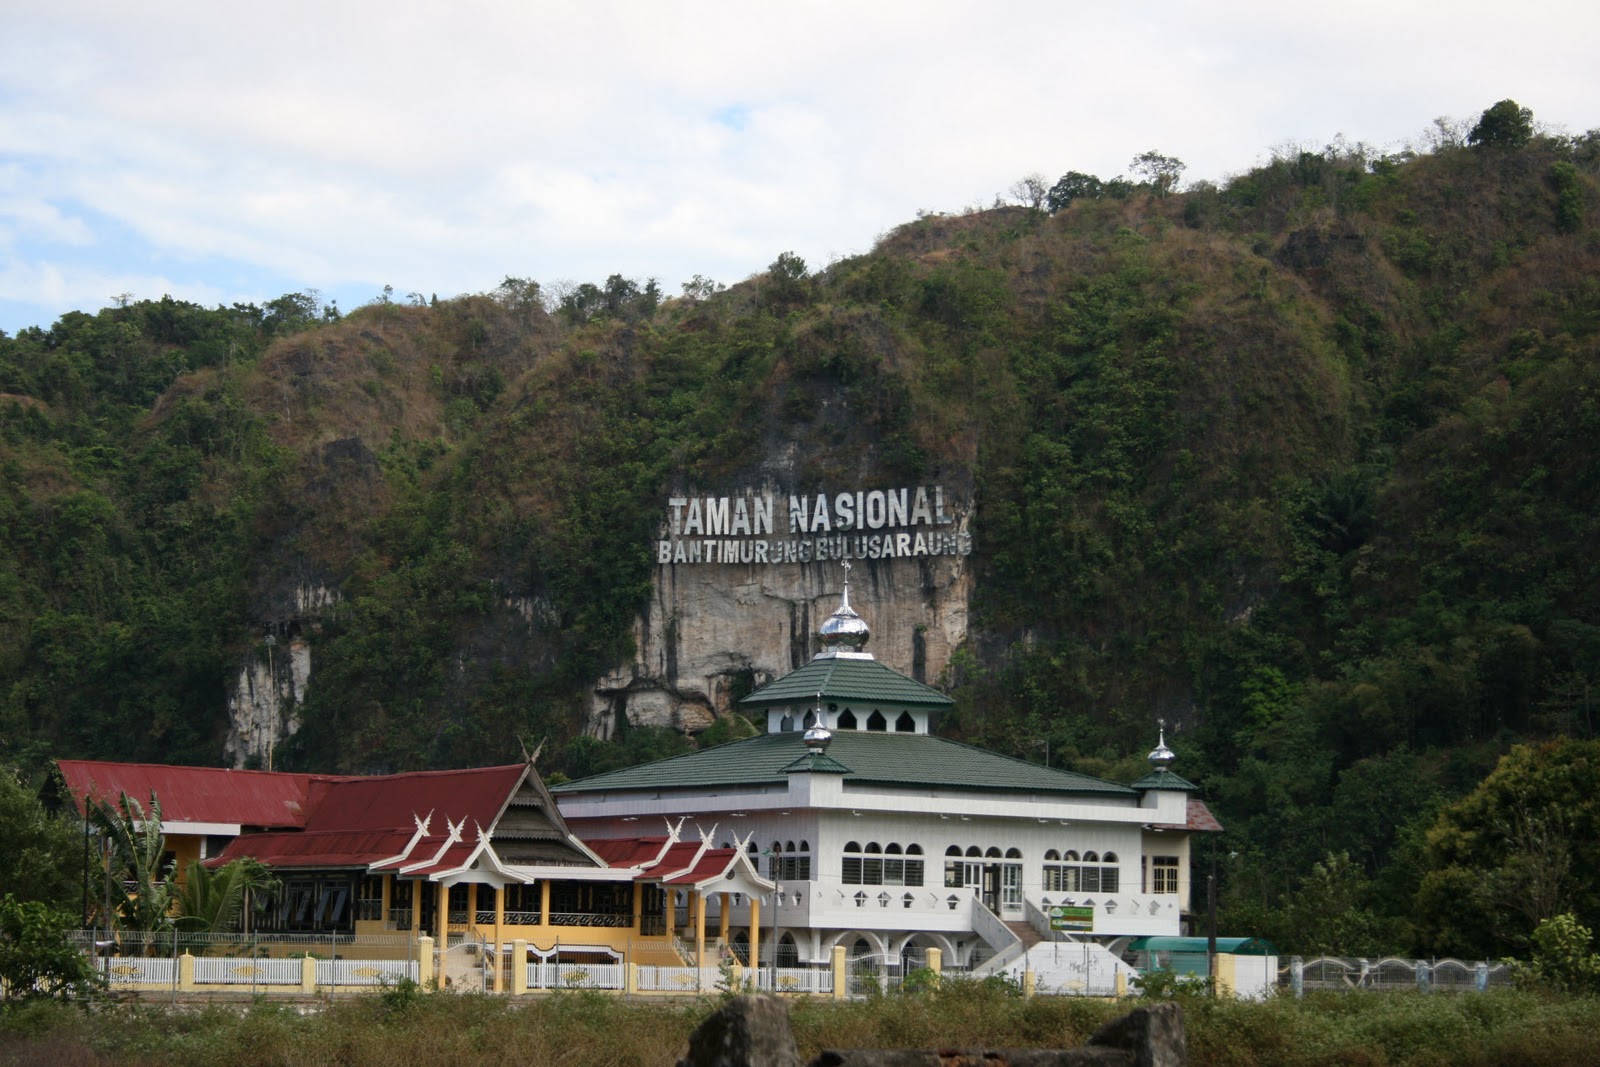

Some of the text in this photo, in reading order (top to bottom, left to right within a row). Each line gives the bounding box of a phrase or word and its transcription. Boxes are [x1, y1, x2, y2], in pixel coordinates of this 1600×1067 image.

[668, 486, 952, 535] TAMAN NASIONAL
[658, 539, 812, 564] BANTIMURUNG
